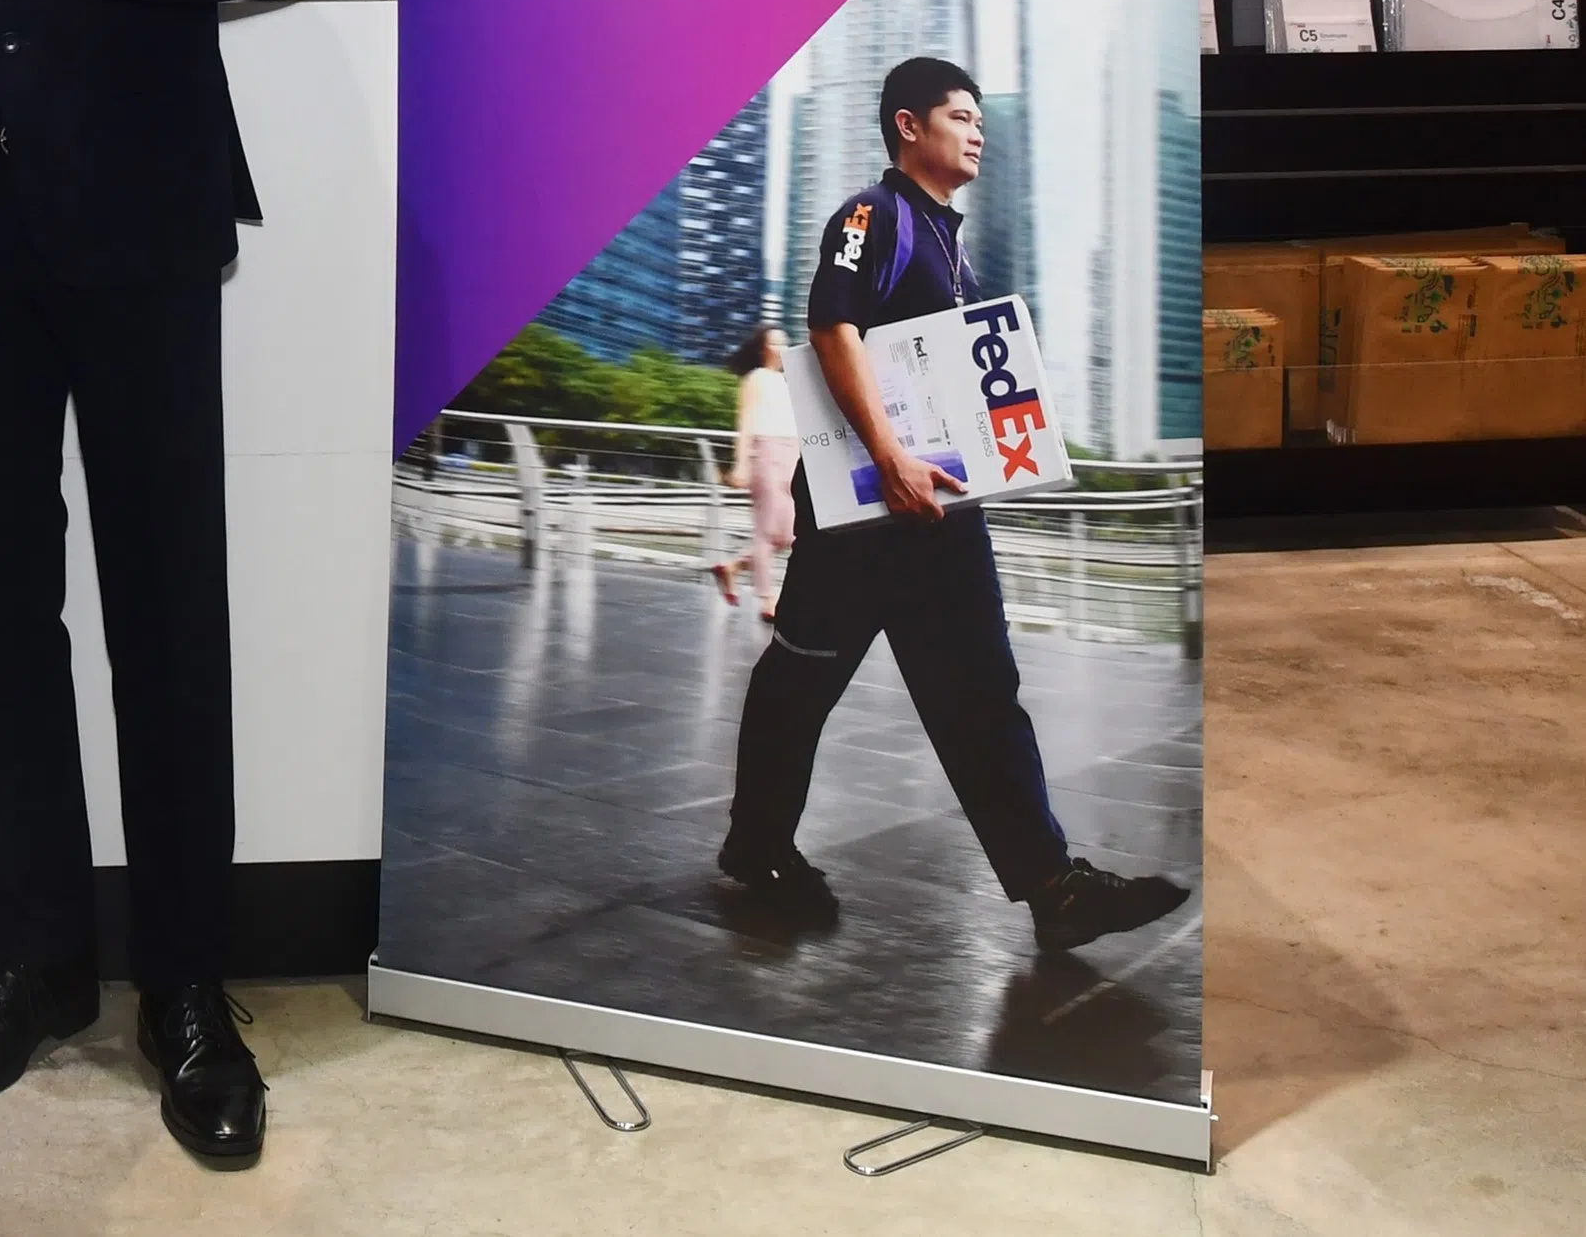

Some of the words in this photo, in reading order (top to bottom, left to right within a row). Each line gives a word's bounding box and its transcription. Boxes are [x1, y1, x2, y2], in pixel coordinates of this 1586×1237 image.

[1299, 29, 1318, 42] C5
[834, 202, 873, 273] FedEx
[963, 301, 1047, 483] FedEx
[802, 432, 830, 447] Box
[976, 411, 994, 458] Express
